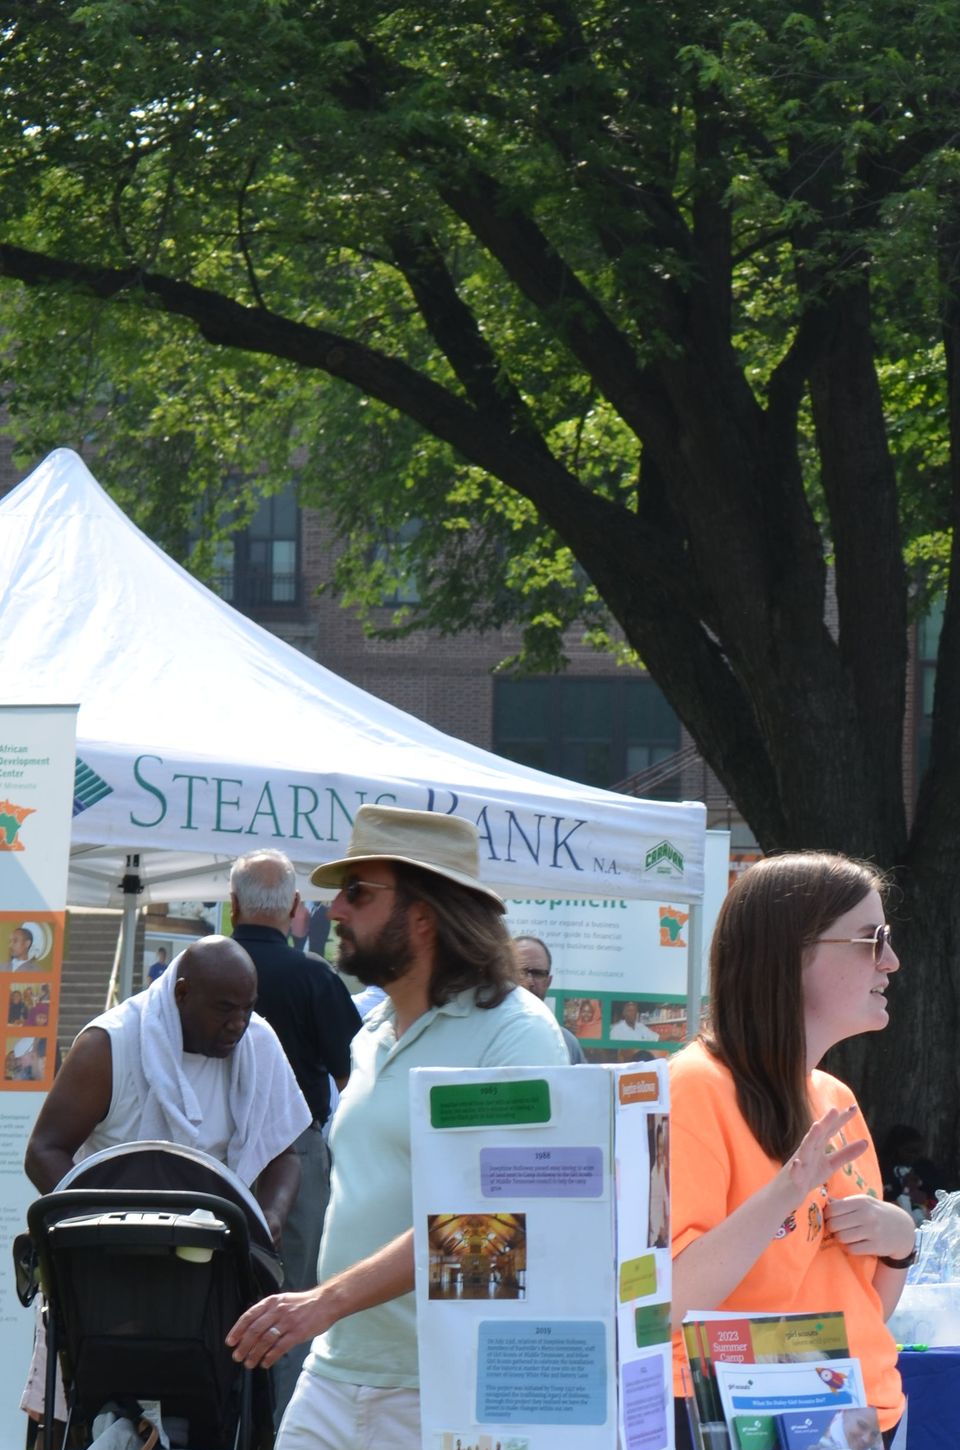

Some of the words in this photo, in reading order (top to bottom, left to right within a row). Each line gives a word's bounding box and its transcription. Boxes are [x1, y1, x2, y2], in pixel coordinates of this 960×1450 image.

[593, 857, 621, 875] N.A.
[717, 1331, 739, 1342] 2023
[713, 1343, 748, 1352] Summer
[720, 1353, 745, 1364] Camp
